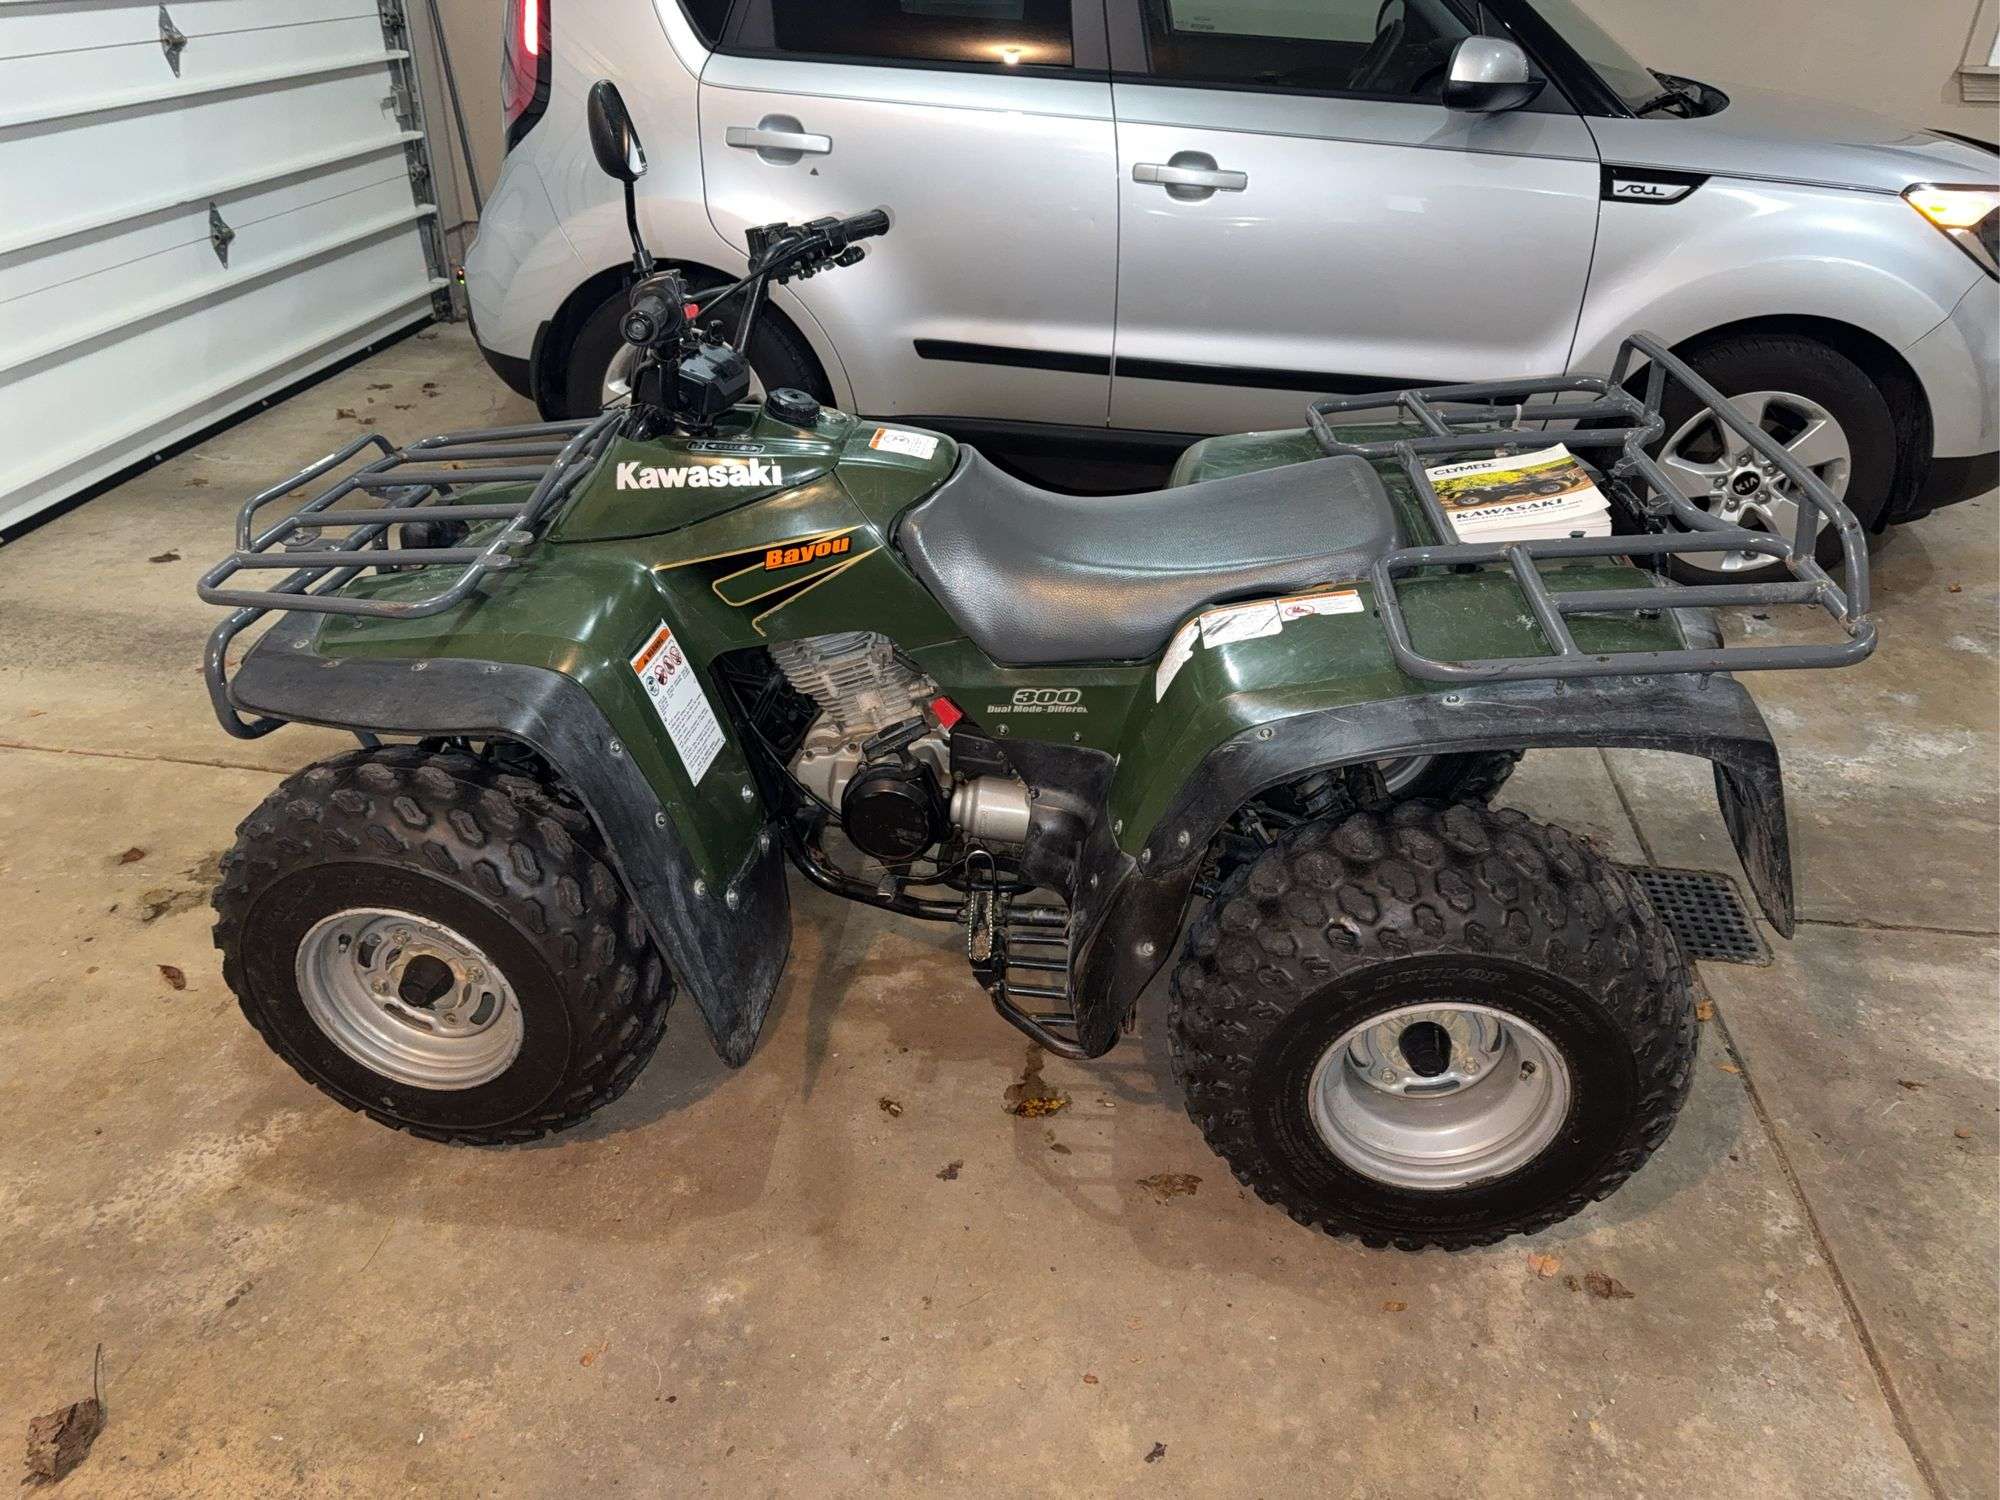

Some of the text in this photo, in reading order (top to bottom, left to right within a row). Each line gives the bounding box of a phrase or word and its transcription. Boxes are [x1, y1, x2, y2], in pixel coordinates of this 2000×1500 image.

[616, 458, 783, 490] Kawasaki
[1735, 477, 1758, 492] KIA
[1456, 498, 1563, 519] KAWASAKI
[764, 537, 849, 568] Bayou
[1013, 689, 1081, 705] 300
[987, 705, 1011, 713] Dual
